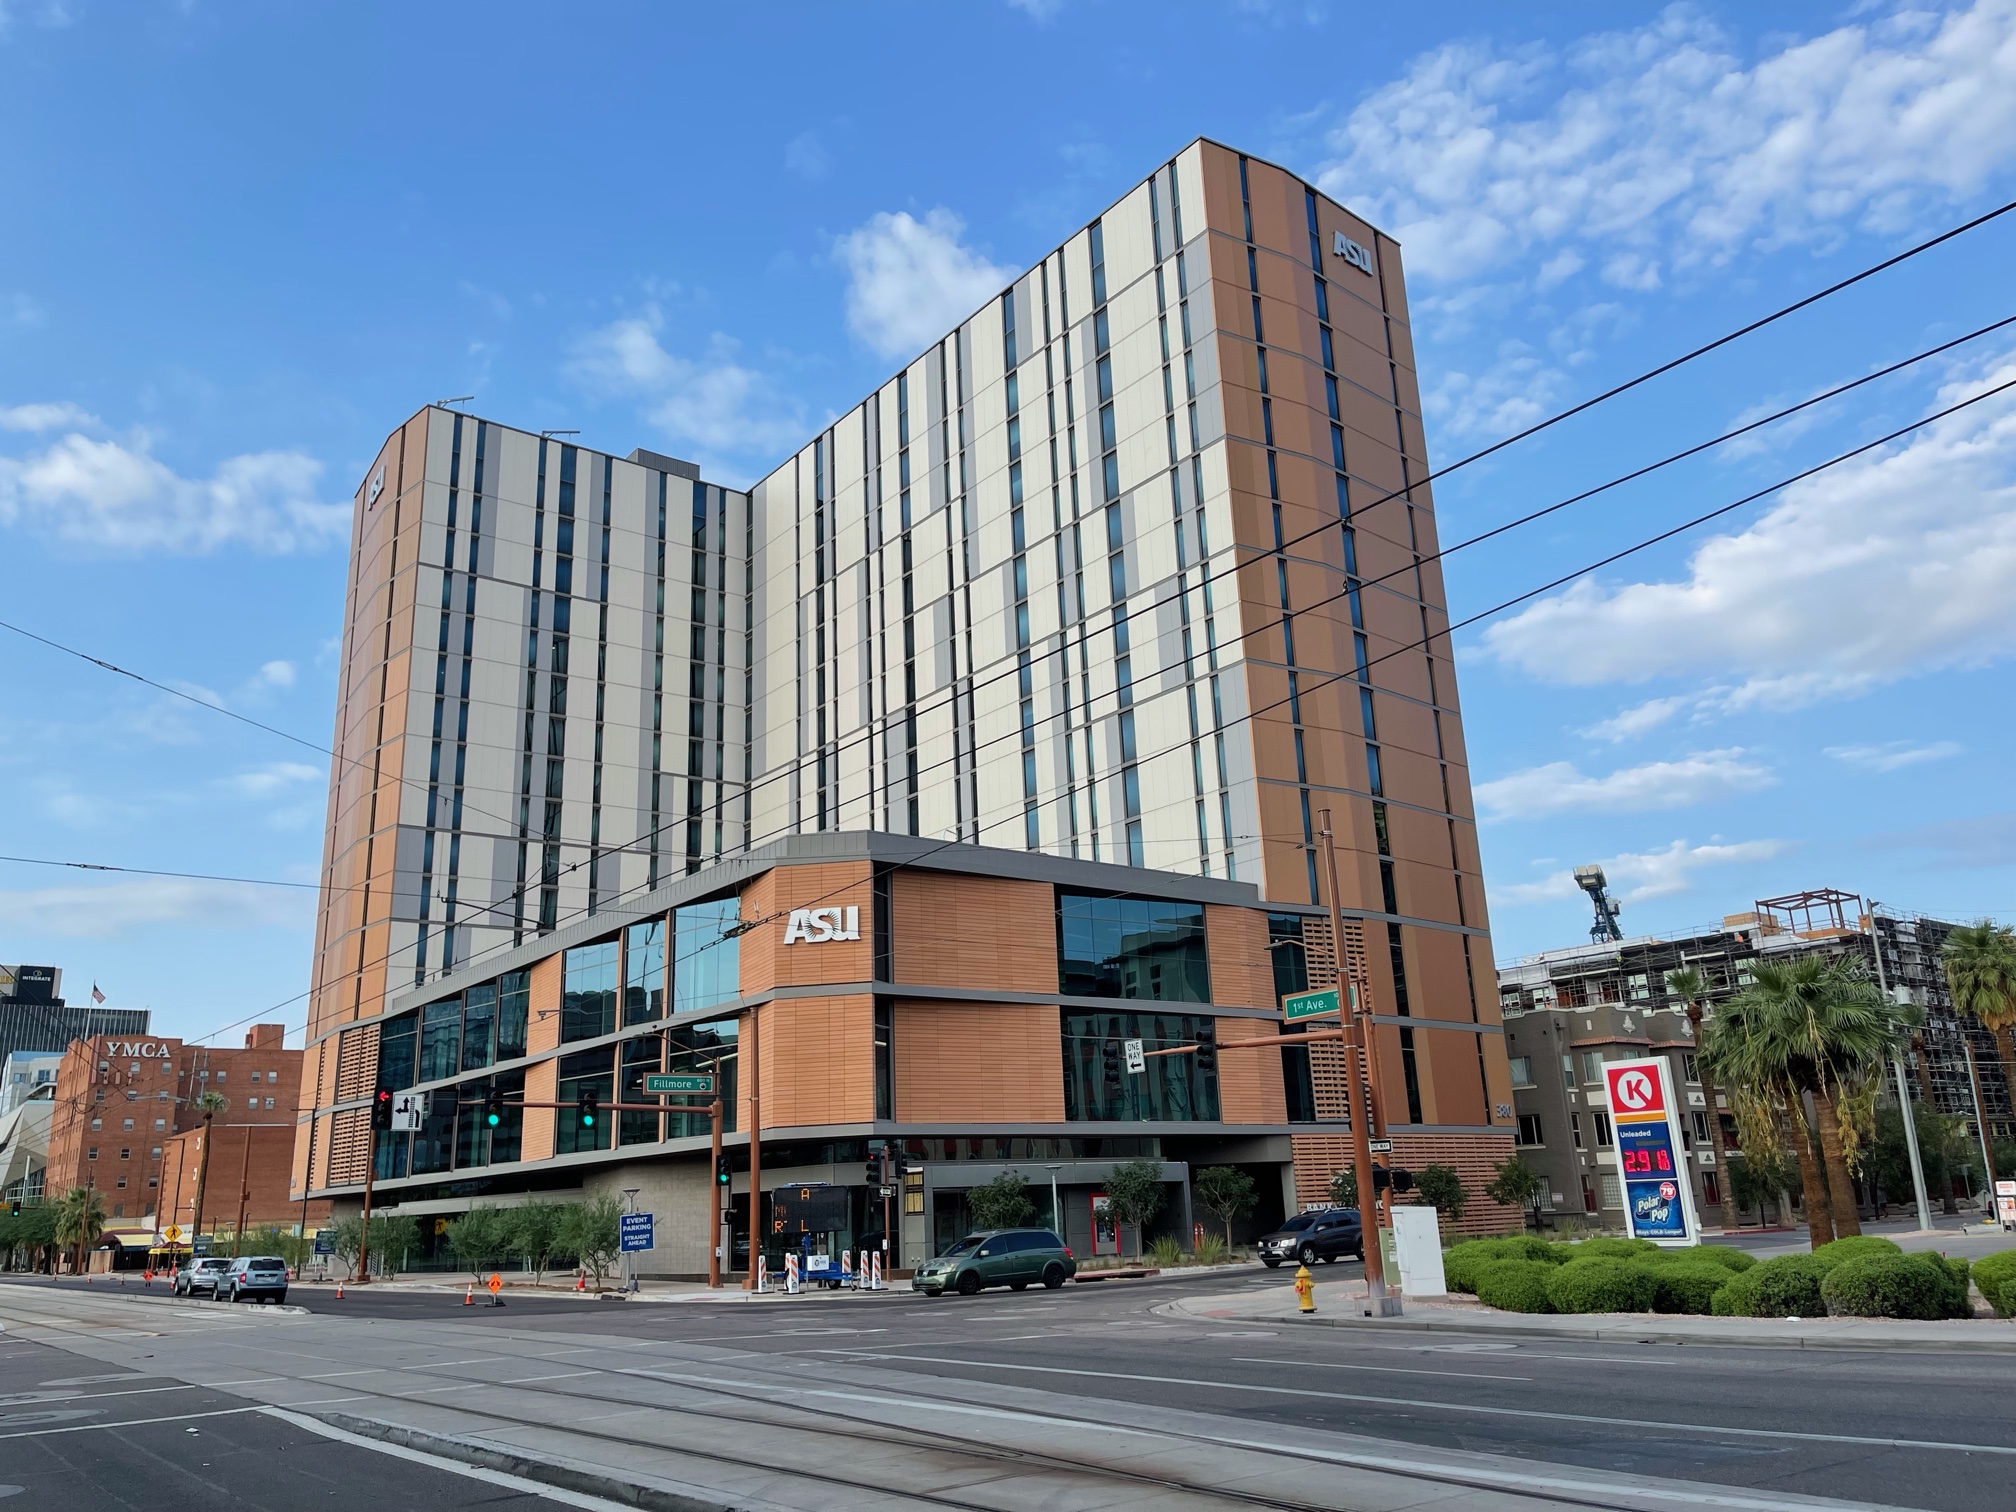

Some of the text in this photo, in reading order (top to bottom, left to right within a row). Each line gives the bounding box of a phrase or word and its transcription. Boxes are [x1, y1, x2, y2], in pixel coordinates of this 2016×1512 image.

[1333, 230, 1373, 277] ASU
[784, 906, 861, 944] ASU
[1293, 1000, 1327, 1013] 1st Ave.
[106, 1041, 171, 1058] YMCA
[1128, 1042, 1140, 1051] ONE
[1128, 1051, 1141, 1060] WAY
[653, 1080, 692, 1088] Fillmore
[1626, 1079, 1651, 1103] K
[1620, 1130, 1651, 1138] Unleaded
[1638, 1196, 1660, 1212] Polar
[1651, 1208, 1668, 1222] Pop
[623, 1224, 651, 1232] PARKING
